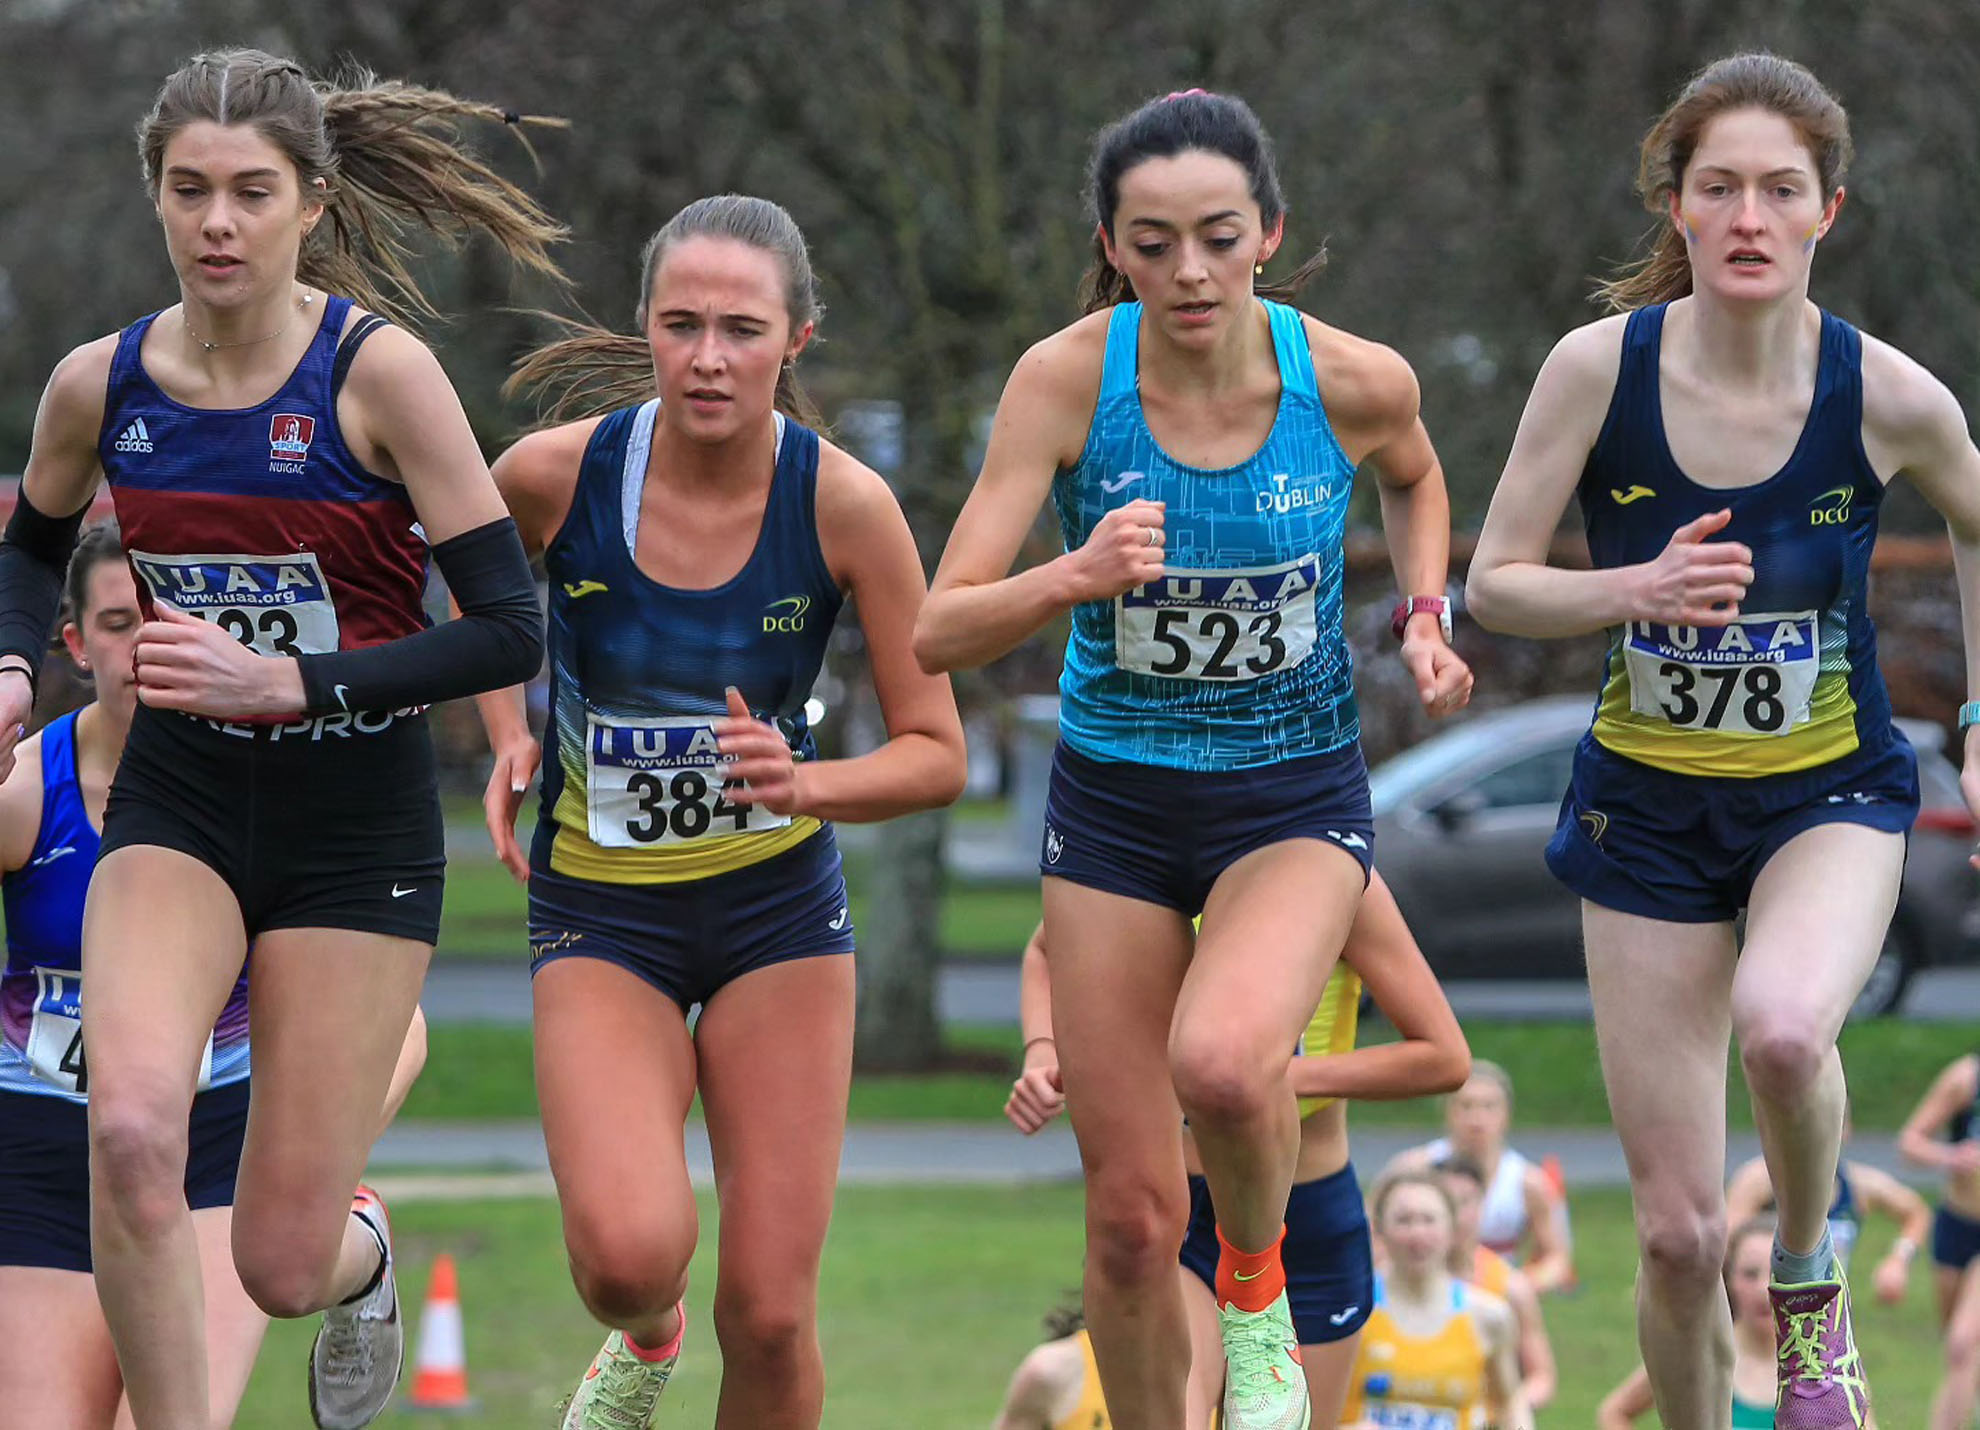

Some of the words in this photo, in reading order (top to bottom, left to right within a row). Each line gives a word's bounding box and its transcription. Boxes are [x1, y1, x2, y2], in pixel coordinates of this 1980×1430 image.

[115, 438, 154, 453] adidas
[274, 442, 306, 451] SPORT
[269, 462, 305, 475] NUIGAC
[1811, 507, 1849, 525] DCU
[763, 616, 804, 632] DCU
[1151, 610, 1286, 678] 523
[1658, 643, 1786, 664] www.iuaa.org
[1660, 663, 1785, 732] 378
[626, 771, 753, 842] 384
